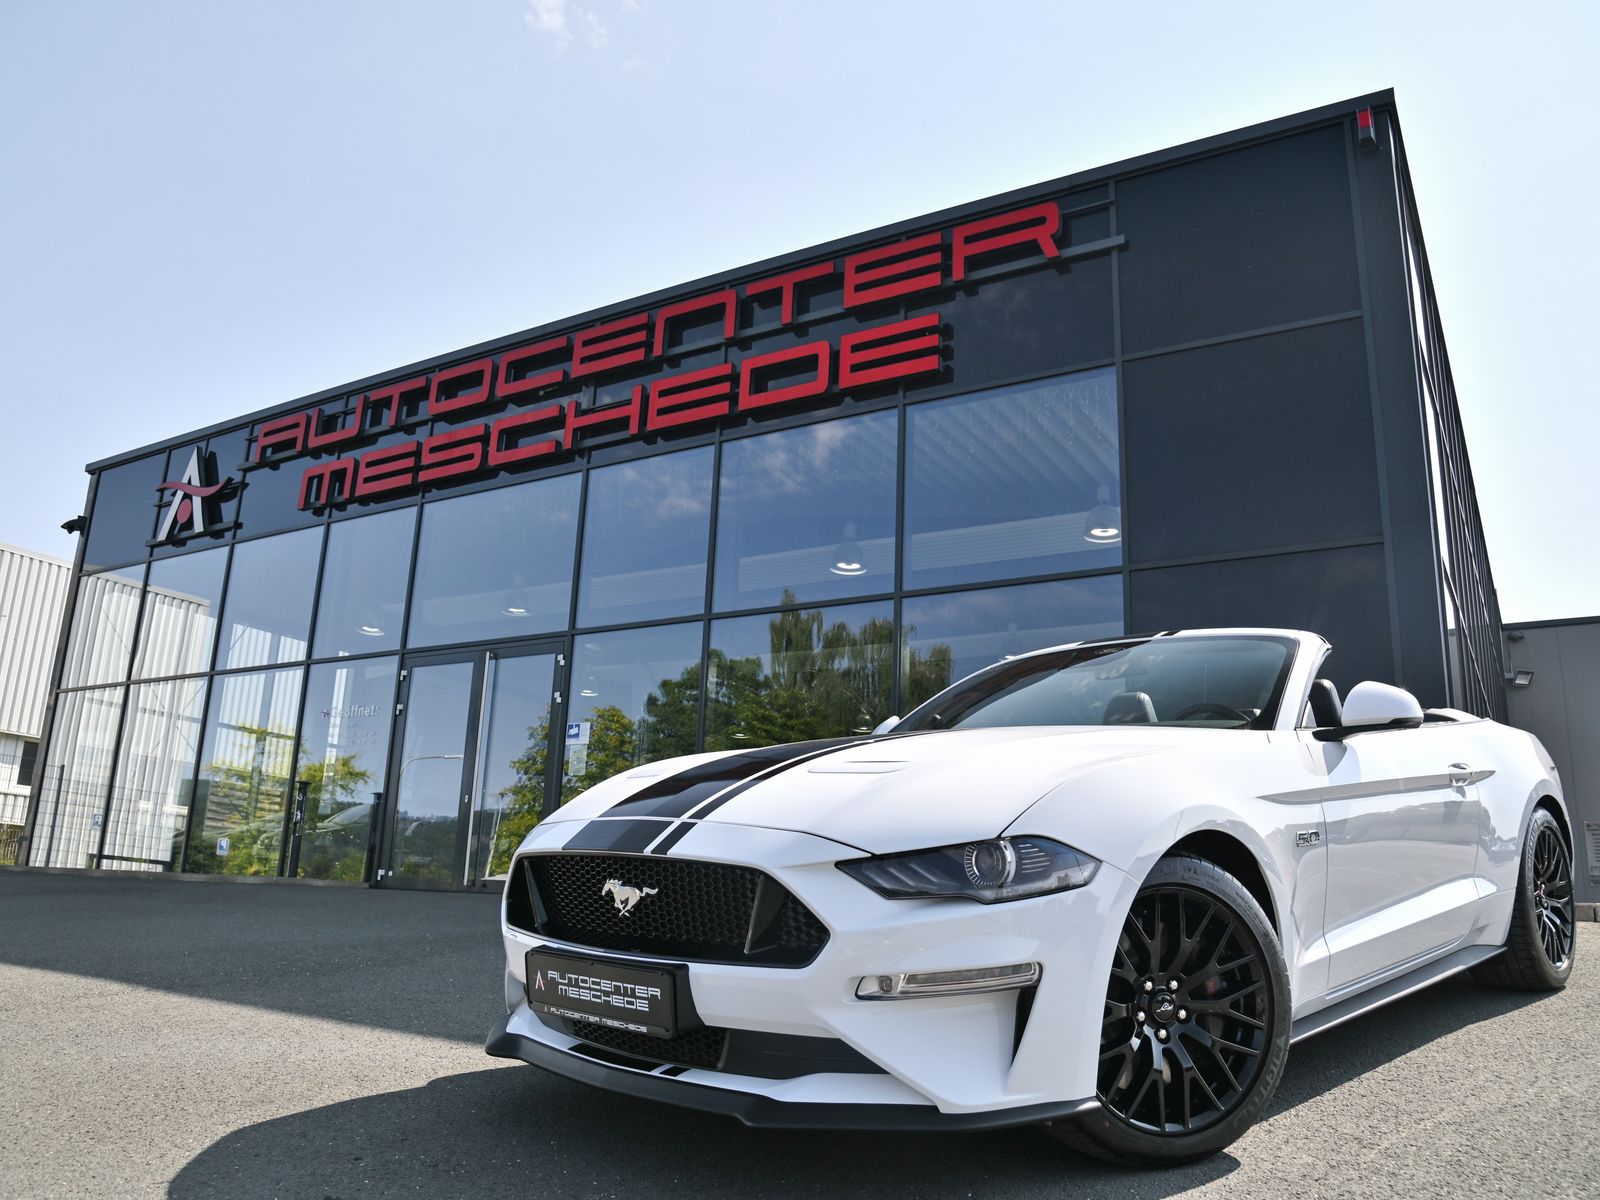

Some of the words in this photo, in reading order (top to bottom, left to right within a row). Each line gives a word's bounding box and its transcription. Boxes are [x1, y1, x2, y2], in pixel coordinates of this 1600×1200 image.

[253, 200, 1063, 464] AUTOCENTER
[296, 312, 942, 511] MESCHEDE
[547, 970, 661, 1000] AUTOCENTER
[558, 984, 649, 1012] MESCHEDE
[550, 1007, 600, 1022] AUTOCENTER
[602, 1018, 648, 1033] MESCHEDE
